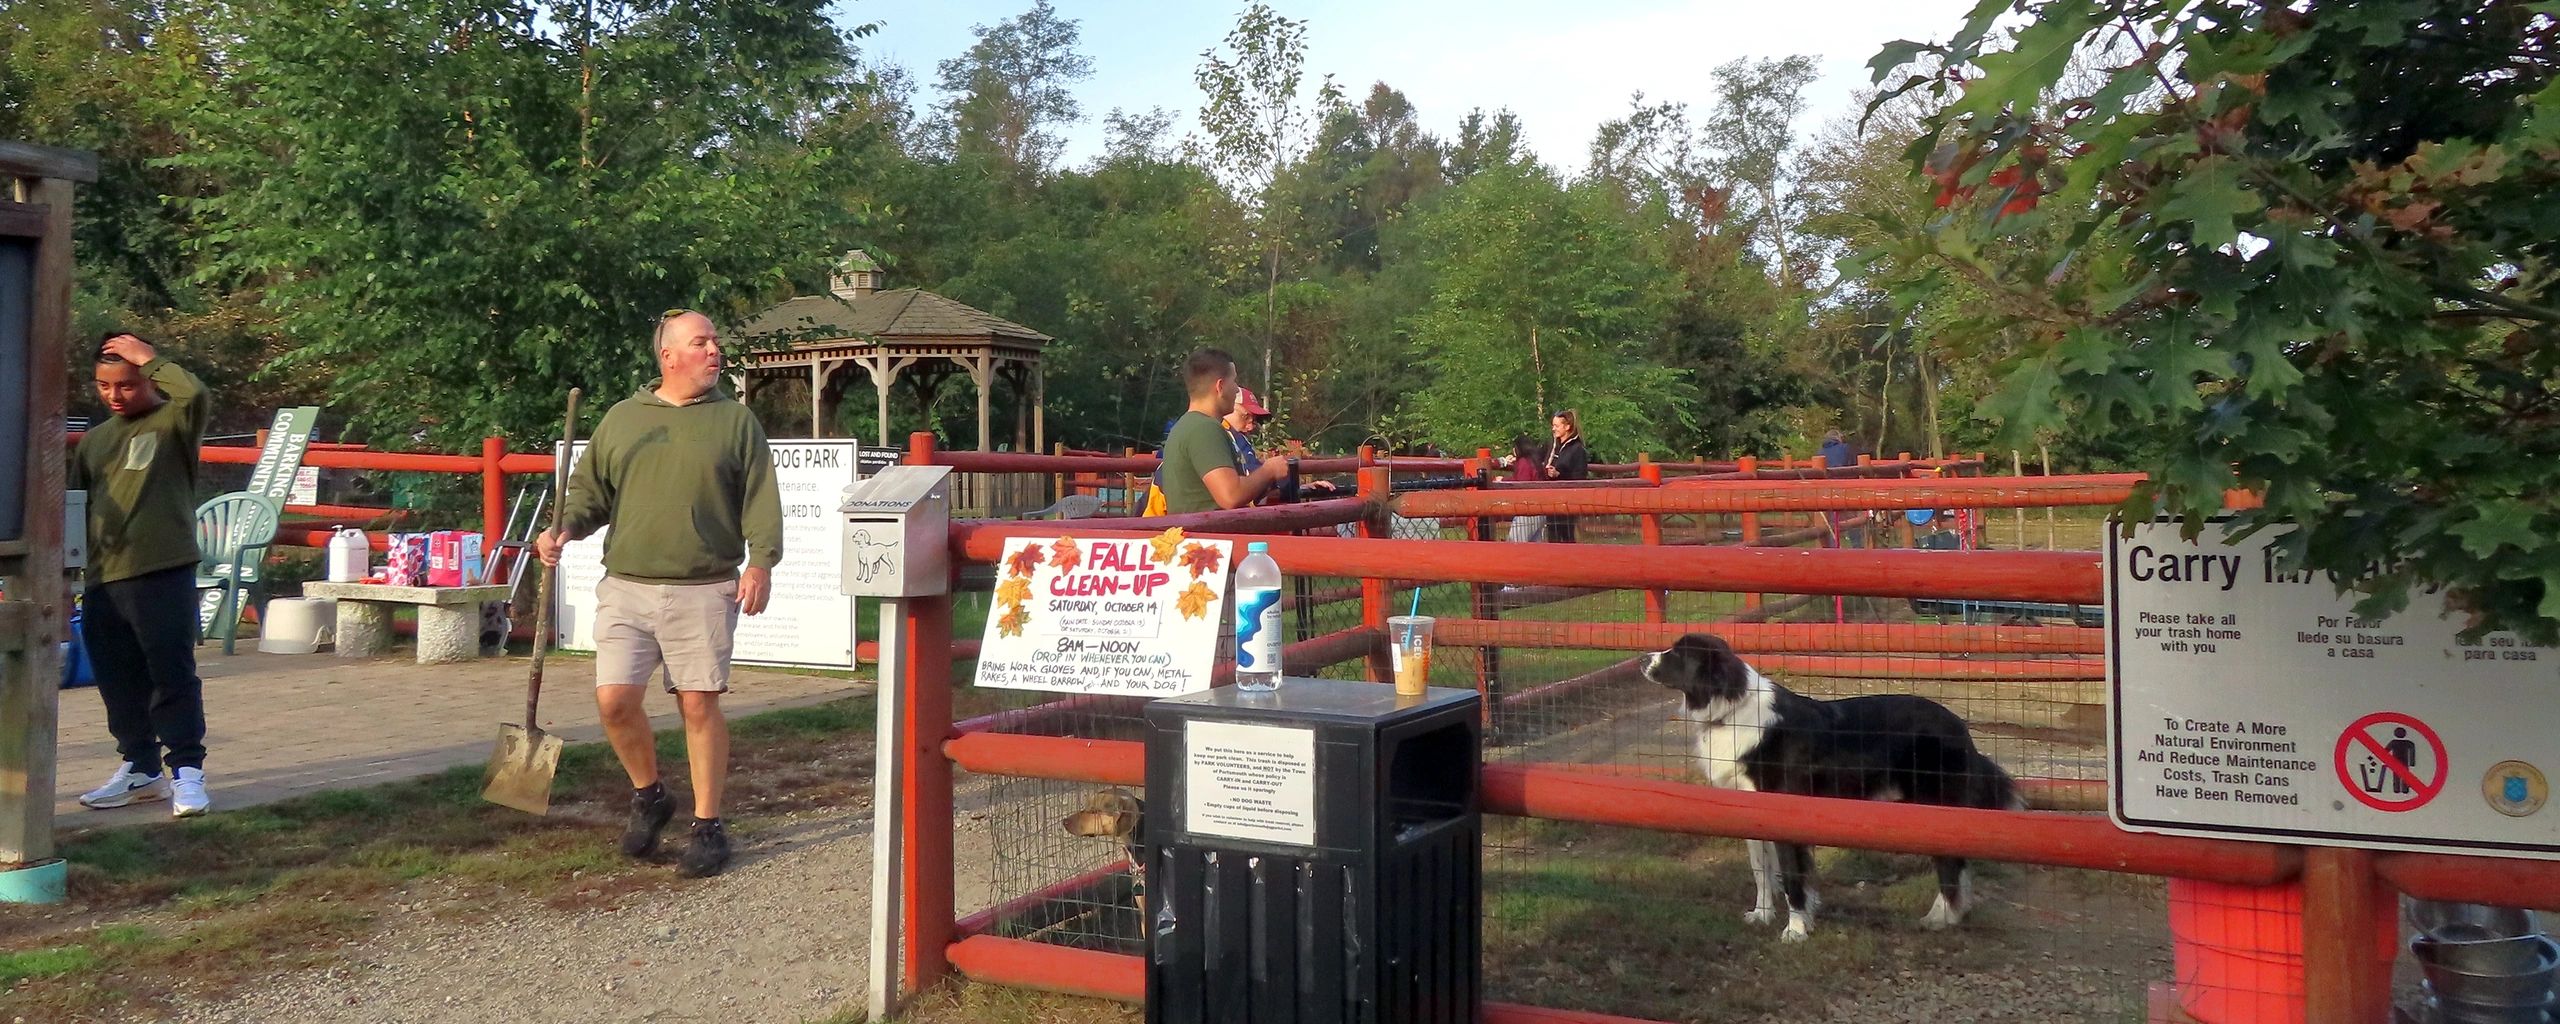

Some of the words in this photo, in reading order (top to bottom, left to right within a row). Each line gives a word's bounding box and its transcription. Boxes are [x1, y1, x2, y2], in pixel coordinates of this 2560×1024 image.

[268, 433, 307, 498] BARKING
[772, 449, 801, 468] DOG
[805, 449, 840, 468] PARK
[778, 482, 819, 492] ntenance.
[783, 505, 808, 518] UIRED
[810, 505, 822, 518] TO
[1088, 542, 1155, 571] FALL
[2129, 545, 2241, 591] Carry
[1050, 572, 1170, 597] CLEAN-UP
[199, 588, 222, 632] OAR
[1048, 599, 1098, 616] SATURDAY,
[1104, 601, 1144, 613] OCTOBER
[1146, 601, 1158, 615] 14
[2139, 612, 2180, 624] Please
[2186, 612, 2215, 625] take
[2220, 614, 2236, 626] all
[2317, 616, 2340, 628] Por
[2345, 616, 2382, 629] Favor
[2135, 628, 2162, 640] your
[2168, 627, 2200, 639] trash
[2206, 628, 2241, 640] home
[2297, 632, 2329, 644] llede
[2335, 634, 2351, 644] su
[2357, 632, 2404, 646] basura
[2490, 636, 2514, 647] seu
[1057, 637, 1084, 653] 8AM
[1099, 640, 1140, 654] NOON
[2160, 640, 2188, 652] with
[2194, 643, 2216, 655] you
[2327, 648, 2336, 658] a
[2342, 648, 2375, 658] casa
[1032, 649, 1063, 663] (DROP
[1065, 653, 1076, 662] IN
[1080, 652, 1129, 664] WHENEVER
[1131, 654, 1146, 664] YOU
[1148, 652, 1172, 668] CAN)
[2464, 650, 2496, 660] para
[2502, 650, 2536, 660] casa
[981, 661, 1006, 671] BRING
[1010, 660, 1037, 673] WORK
[1040, 664, 1076, 675] GLOVES
[1080, 666, 1100, 679] AND,
[1102, 666, 1112, 676] IF
[1114, 667, 1131, 676] YOU
[1133, 666, 1154, 680] CAN,
[1157, 669, 1192, 679] METAL
[980, 671, 1010, 686] RAKES,
[1011, 672, 1018, 683] A
[1022, 673, 1048, 684] WHEEL
[1050, 676, 1086, 686] BARROW
[1100, 678, 1120, 688] AND
[1126, 678, 1150, 690] YOUR
[2164, 718, 2178, 730] To
[2185, 718, 2230, 733] Create
[2236, 722, 2246, 734] A
[2252, 722, 2287, 736] More
[2155, 734, 2204, 748] Natural
[2210, 736, 2296, 753] Environment
[2138, 750, 2164, 763] And
[2170, 751, 2220, 766] Reduce
[2226, 754, 2317, 772] Maintenance
[2163, 768, 2206, 784] Costs,
[2212, 770, 2249, 785] Trash
[2254, 772, 2290, 787] Cans
[2156, 784, 2188, 798] Have
[2194, 787, 2228, 802] Been
[2234, 789, 2299, 806] Removed
